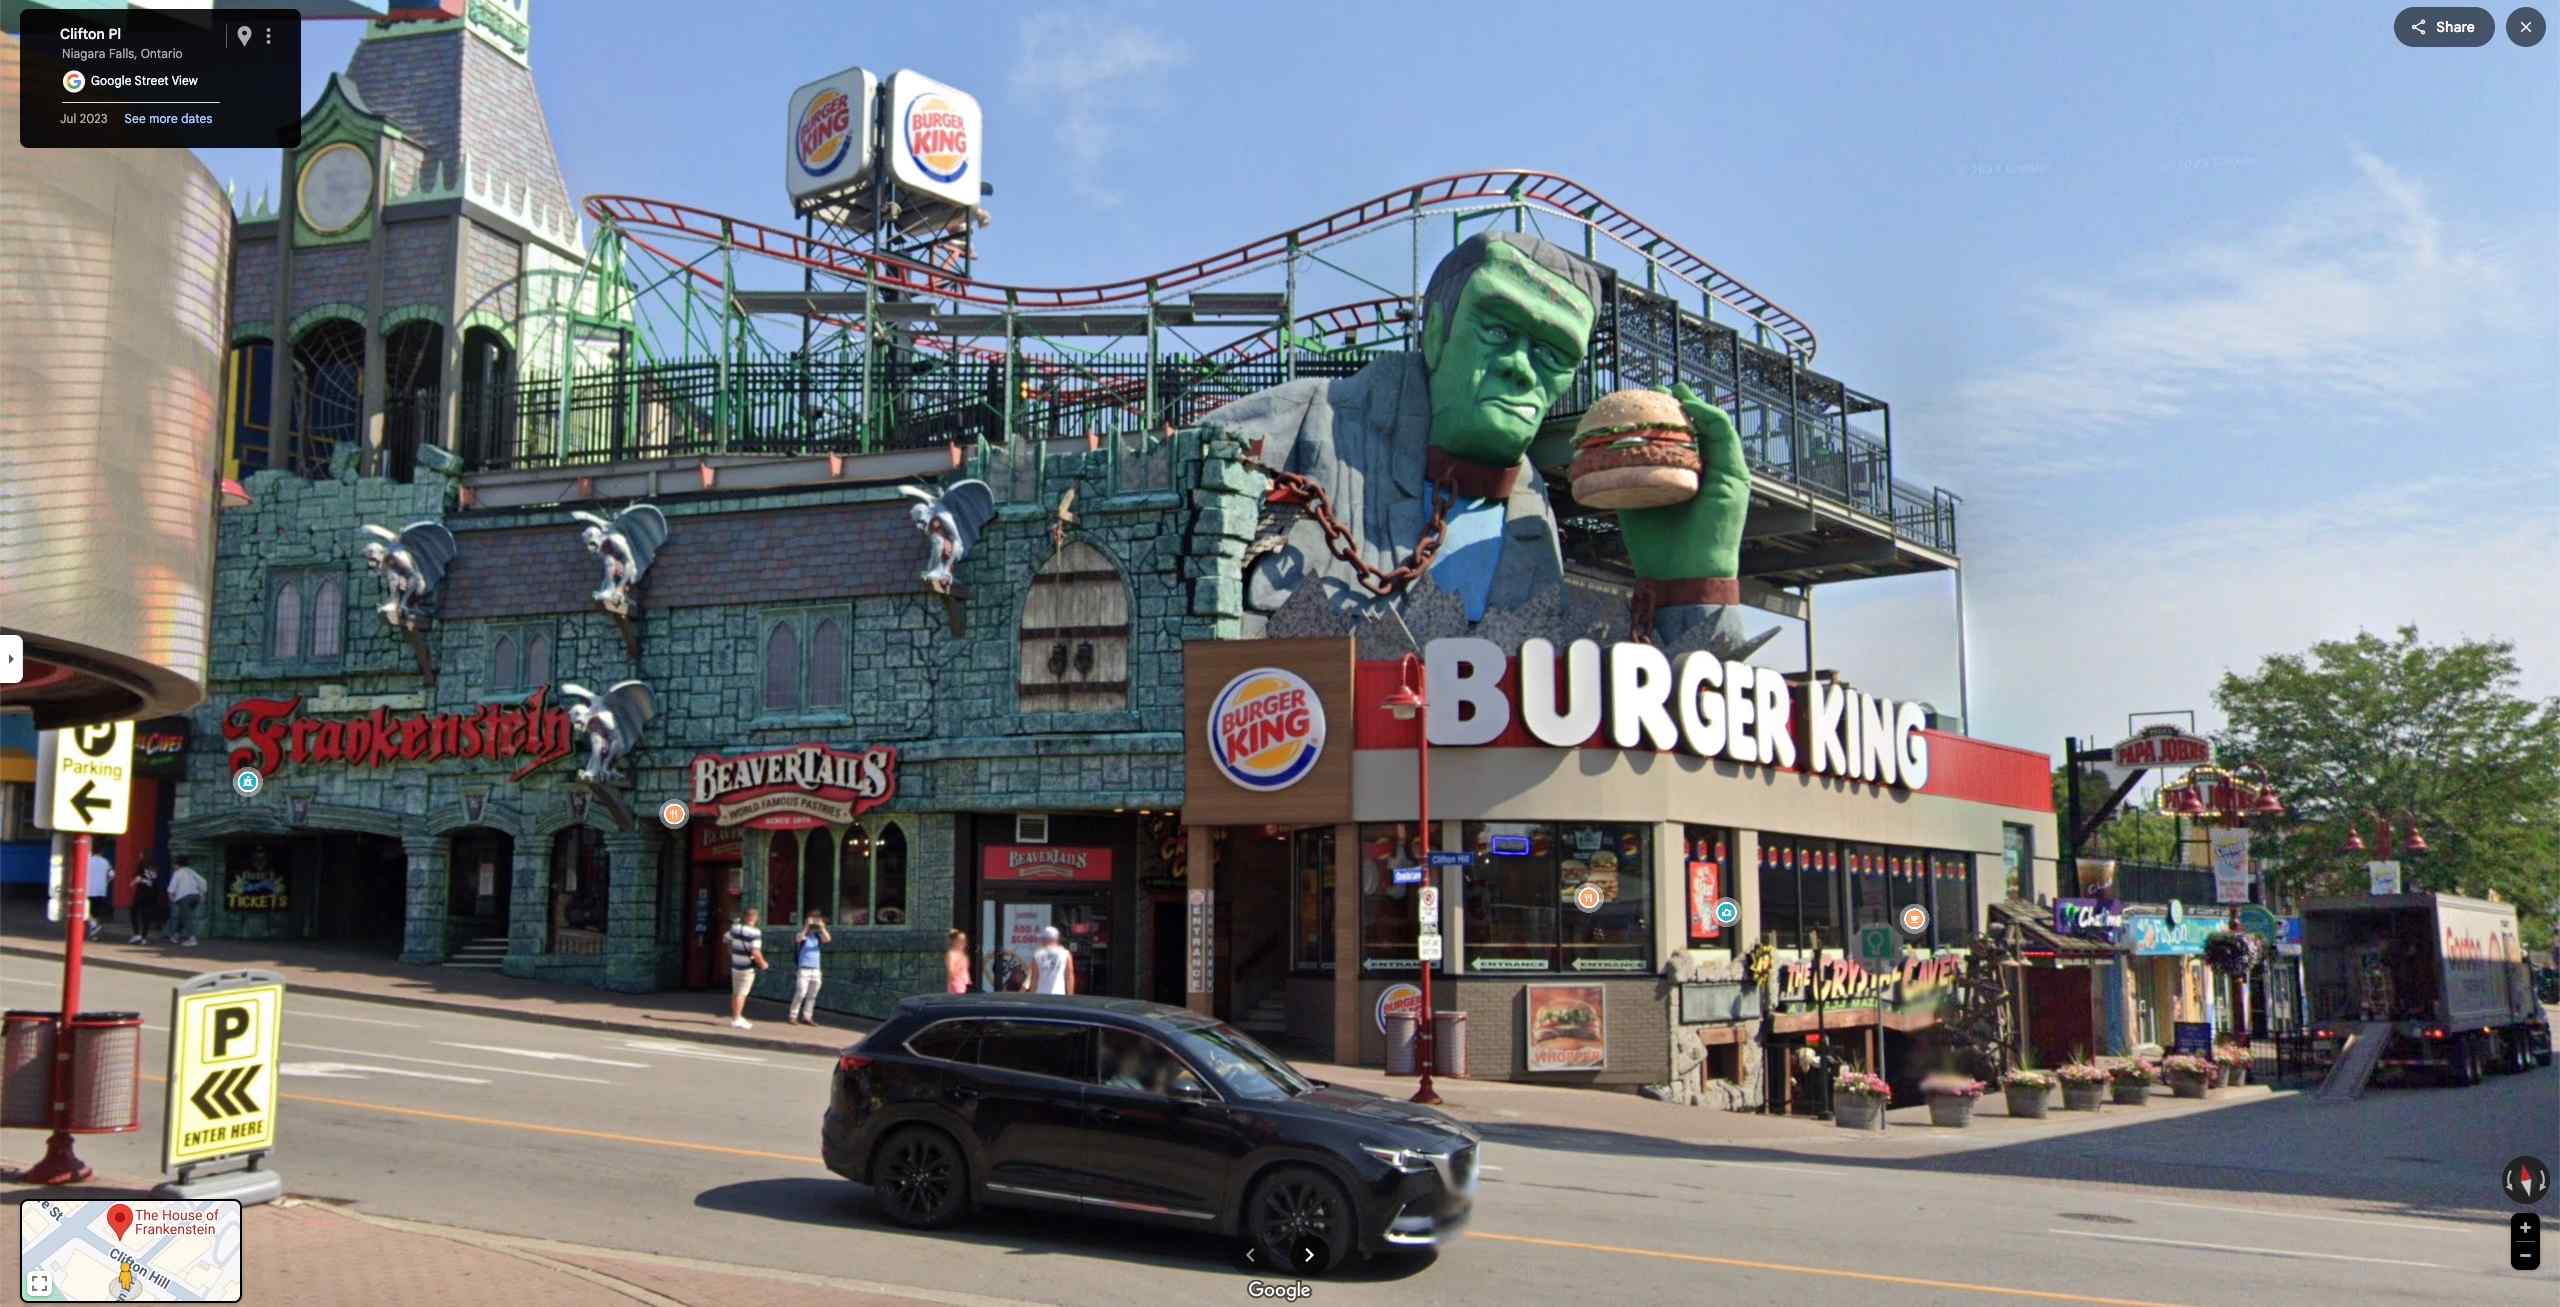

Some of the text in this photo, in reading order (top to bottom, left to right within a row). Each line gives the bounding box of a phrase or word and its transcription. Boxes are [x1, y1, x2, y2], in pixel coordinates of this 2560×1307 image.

[801, 94, 848, 134] BURGER
[801, 109, 849, 163] KING
[912, 112, 965, 130] BURGER
[913, 130, 967, 155] KING
[223, 684, 575, 782] Frankenstein
[1222, 688, 1306, 736] BURGER
[1224, 707, 1311, 765] KING
[1425, 637, 1929, 791] BURGER KING
[62, 757, 123, 781] Parking
[213, 1006, 250, 1058] P
[184, 1119, 264, 1148] ENTER HERE
